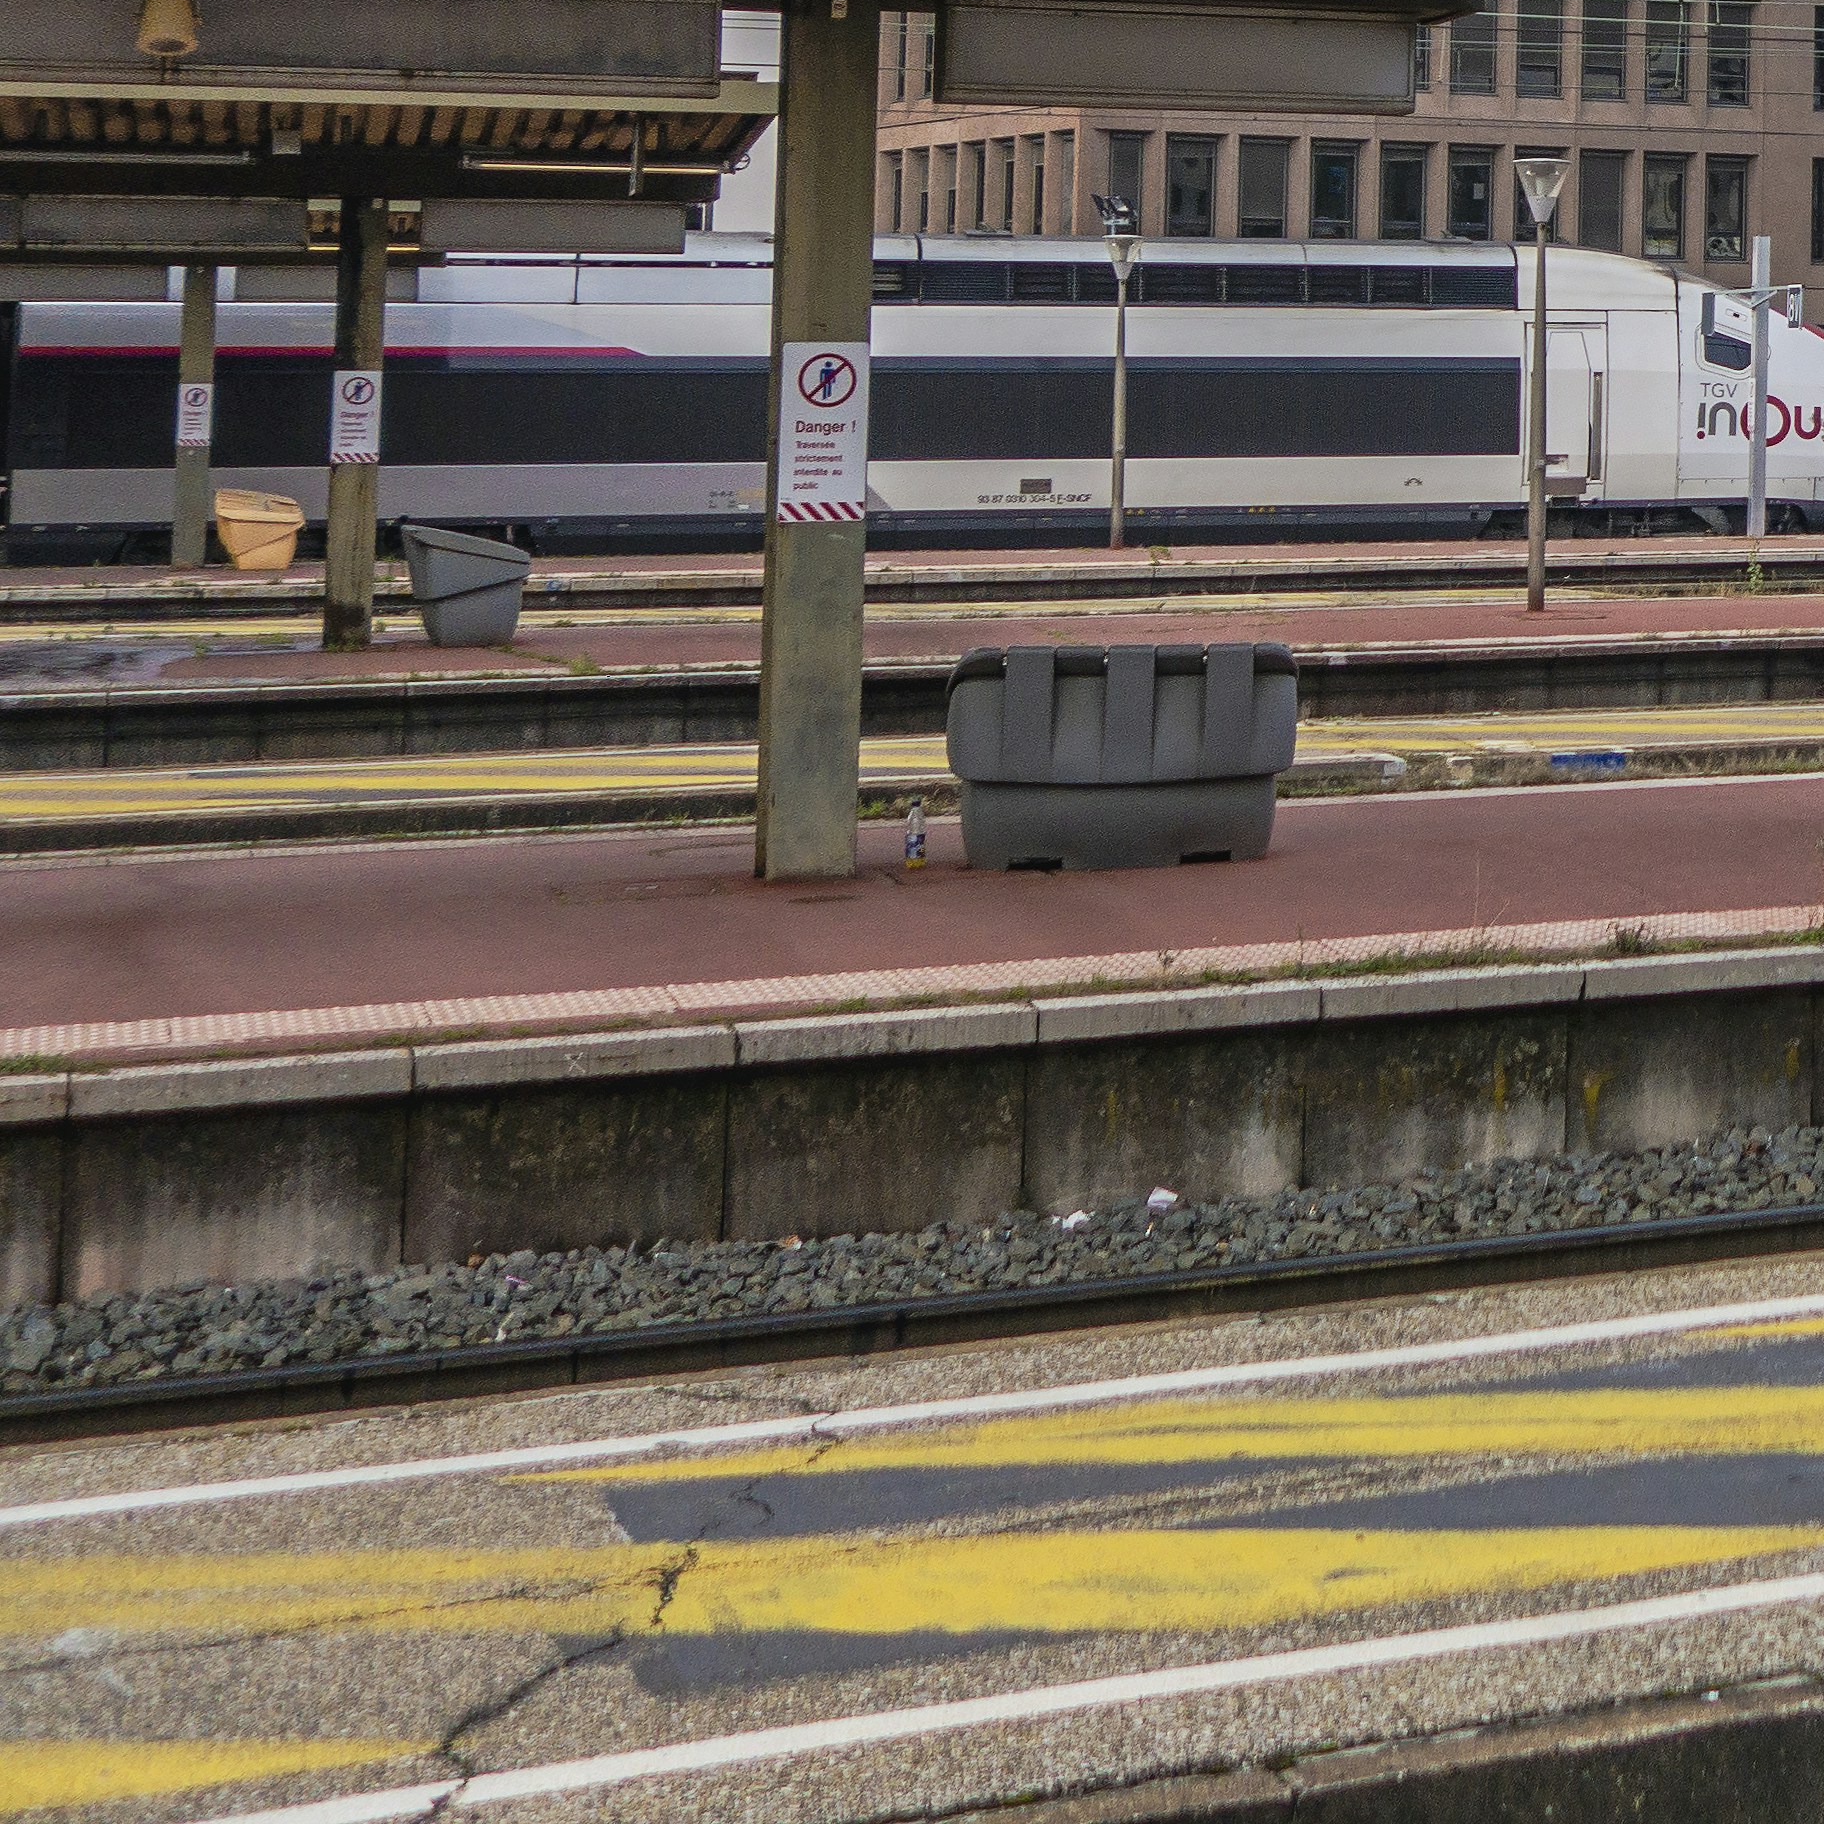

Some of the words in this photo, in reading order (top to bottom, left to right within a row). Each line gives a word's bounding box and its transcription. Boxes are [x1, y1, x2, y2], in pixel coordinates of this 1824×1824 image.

[1700, 382, 1738, 399] TGV
[795, 420, 846, 436] Danger
[851, 420, 857, 434] !
[794, 454, 843, 463] strictement
